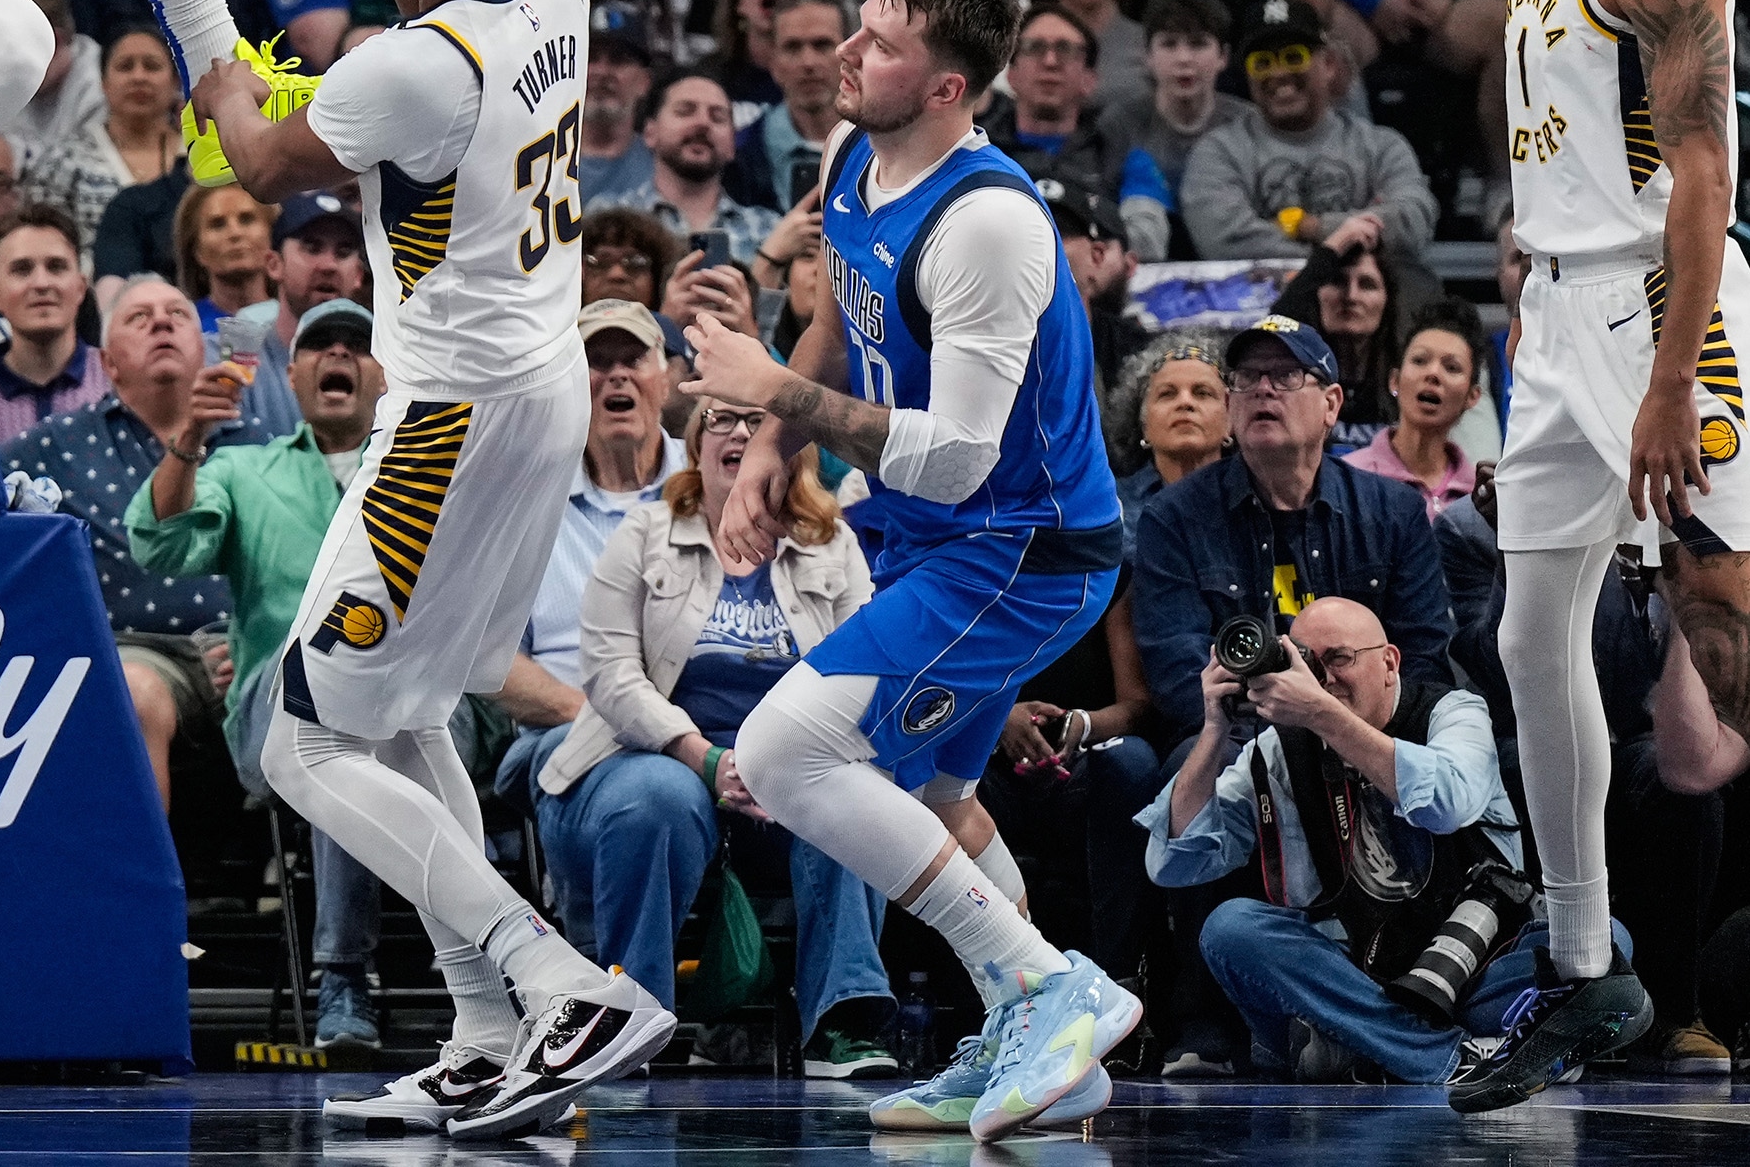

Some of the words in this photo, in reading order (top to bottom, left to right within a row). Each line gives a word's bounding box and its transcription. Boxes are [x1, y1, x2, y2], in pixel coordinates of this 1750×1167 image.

[513, 34, 576, 115] TURNER
[1517, 25, 1531, 110] 1
[514, 99, 584, 275] 33
[873, 241, 895, 269] chime
[1260, 793, 1273, 824] EOS
[1335, 794, 1350, 842] Canon
